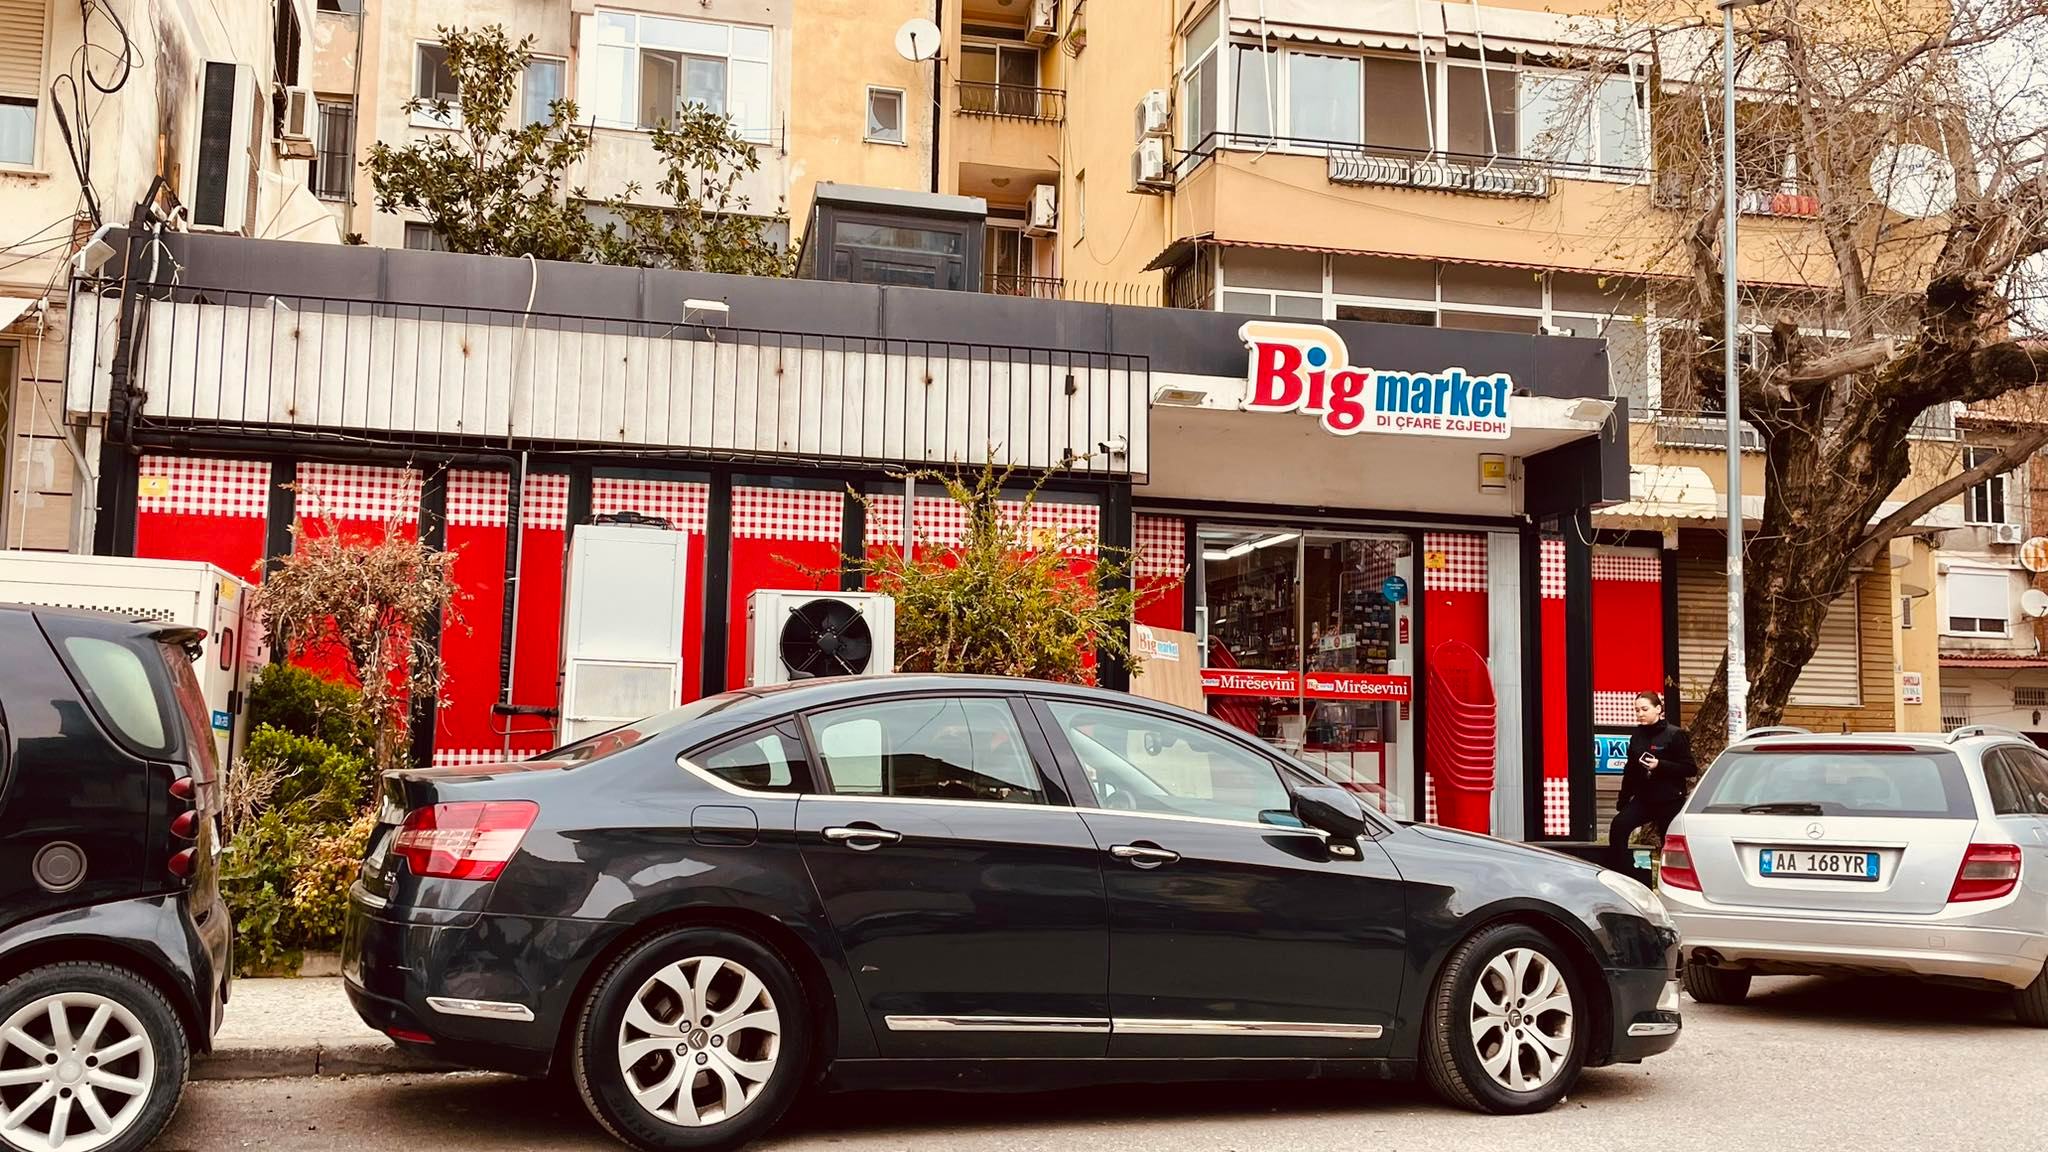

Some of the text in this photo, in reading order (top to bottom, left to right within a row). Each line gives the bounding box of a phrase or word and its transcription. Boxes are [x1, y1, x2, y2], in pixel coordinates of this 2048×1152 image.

[1251, 342, 1507, 430] Big market
[1377, 415, 1391, 426] DI
[1446, 419, 1506, 433] ZGJEDH!
[1220, 675, 1295, 691] Mirësevini
[1334, 680, 1408, 695] Mirësevini
[1776, 853, 1865, 873] AA 168 YR
